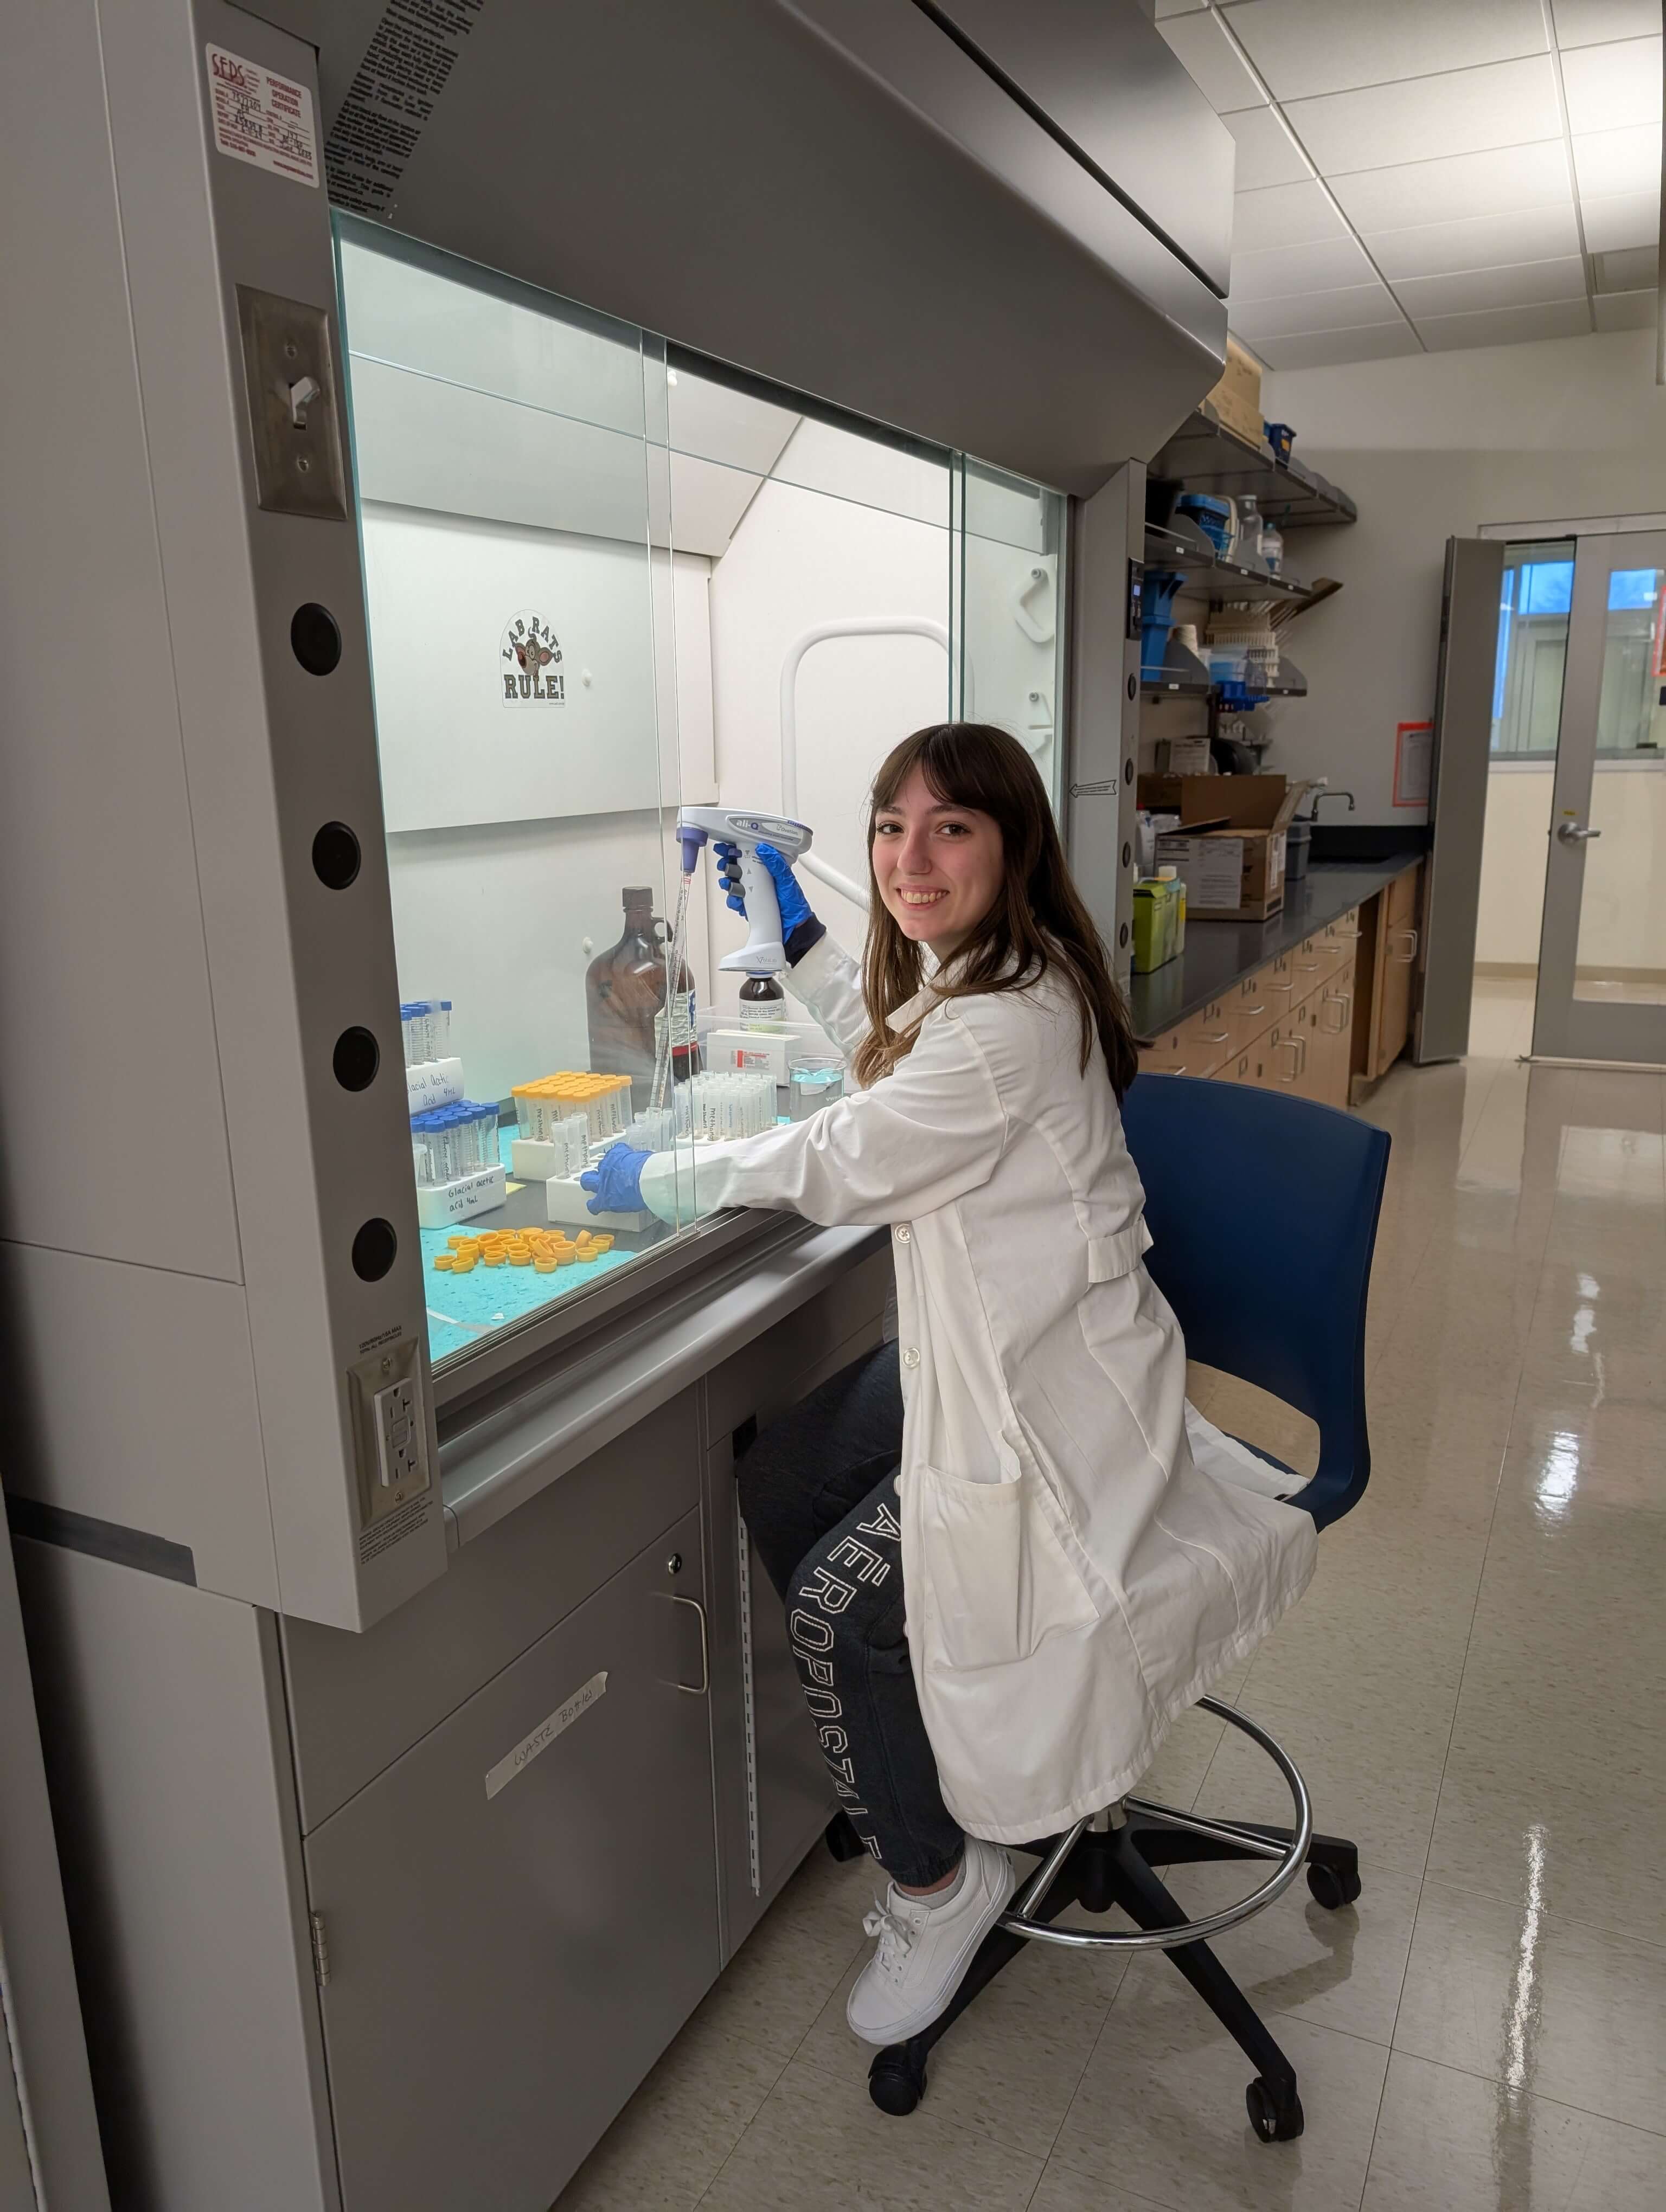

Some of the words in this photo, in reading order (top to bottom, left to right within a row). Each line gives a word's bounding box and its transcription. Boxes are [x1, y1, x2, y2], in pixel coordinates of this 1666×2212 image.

[272, 89, 298, 107] OPERATION
[271, 99, 301, 118] CERTIFICATE
[503, 619, 525, 661] LAB
[531, 616, 562, 663] RATS
[503, 674, 564, 699] RULE!
[736, 819, 759, 831] ali-Q
[448, 1181, 473, 1198] Glacial
[476, 1176, 494, 1187] acetic
[450, 1199, 463, 1212] acid
